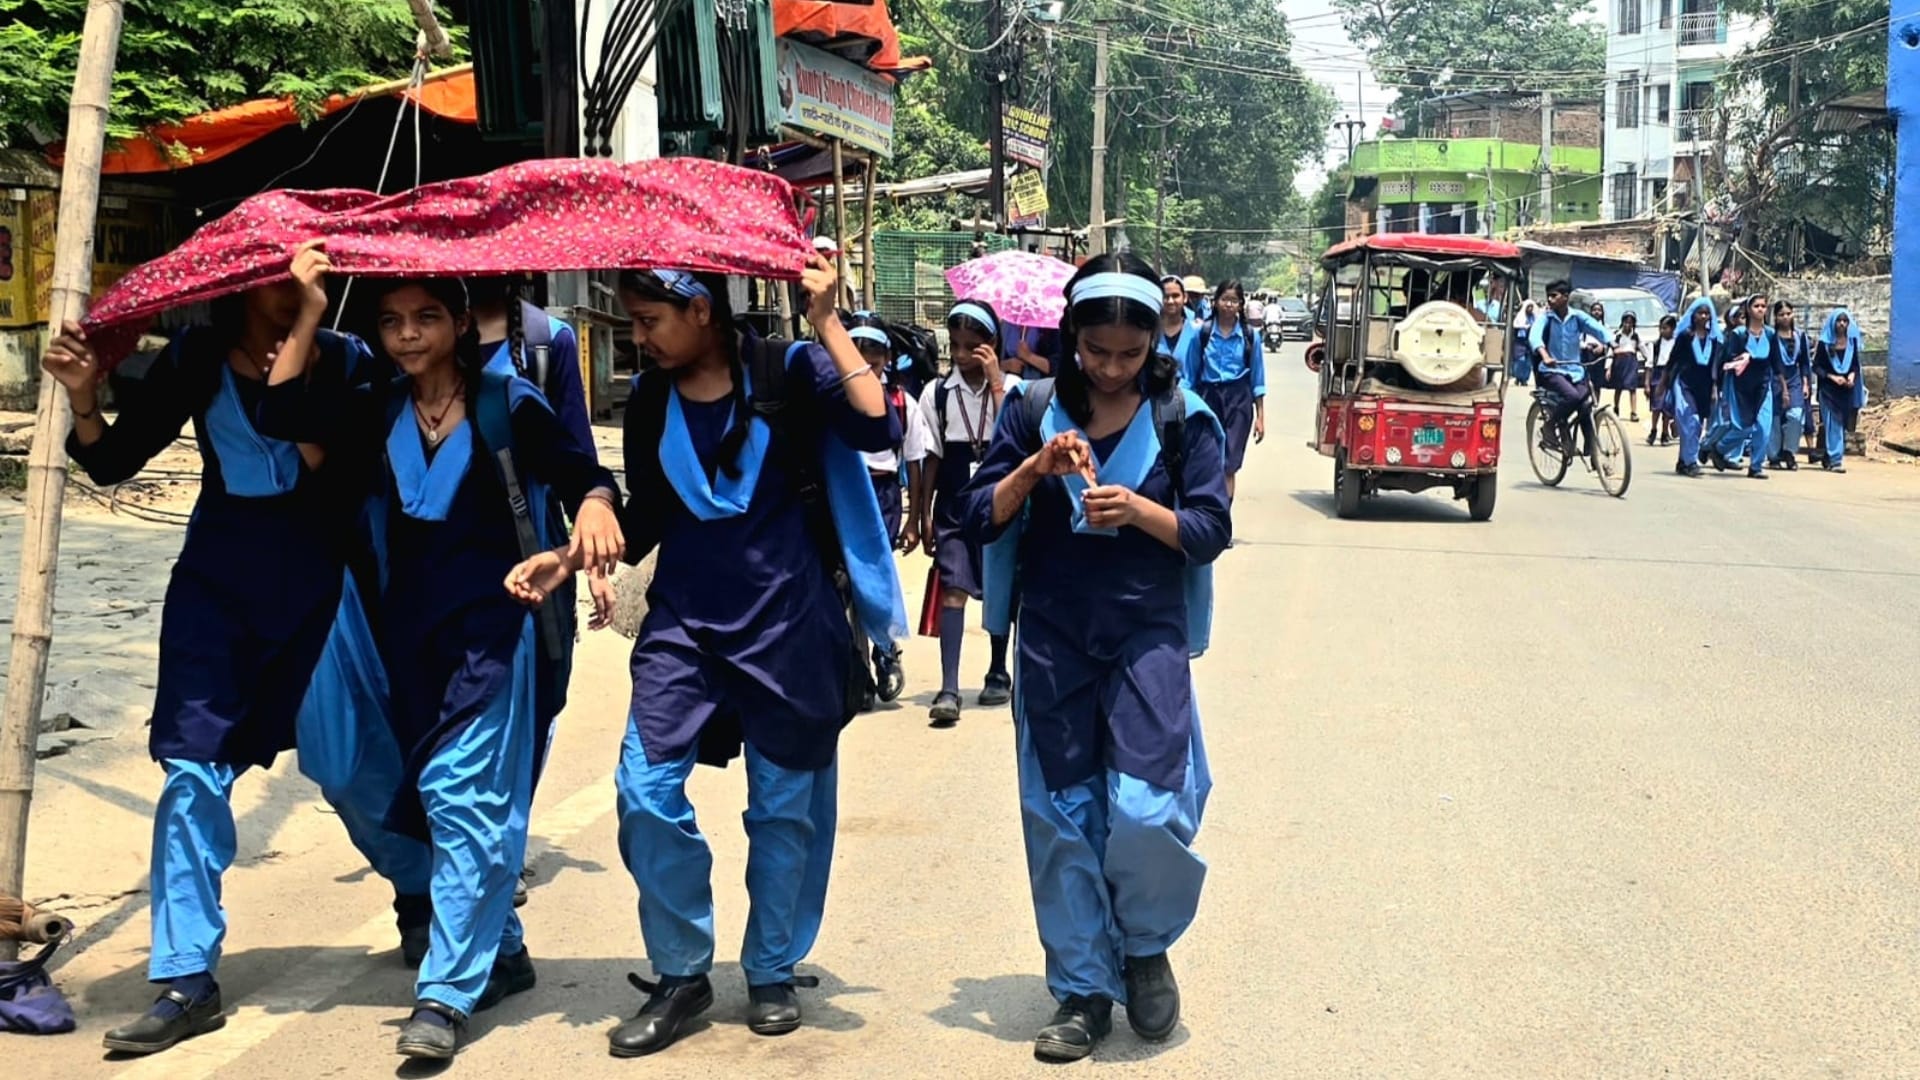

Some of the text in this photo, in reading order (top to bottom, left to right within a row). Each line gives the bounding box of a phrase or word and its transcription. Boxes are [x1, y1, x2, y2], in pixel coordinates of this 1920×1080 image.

[796, 60, 822, 103] Bunty
[823, 69, 846, 111] Singh
[847, 80, 873, 121] Chicken
[1008, 105, 1051, 129] GUIDELINE
[1019, 119, 1048, 140] SCHOOL
